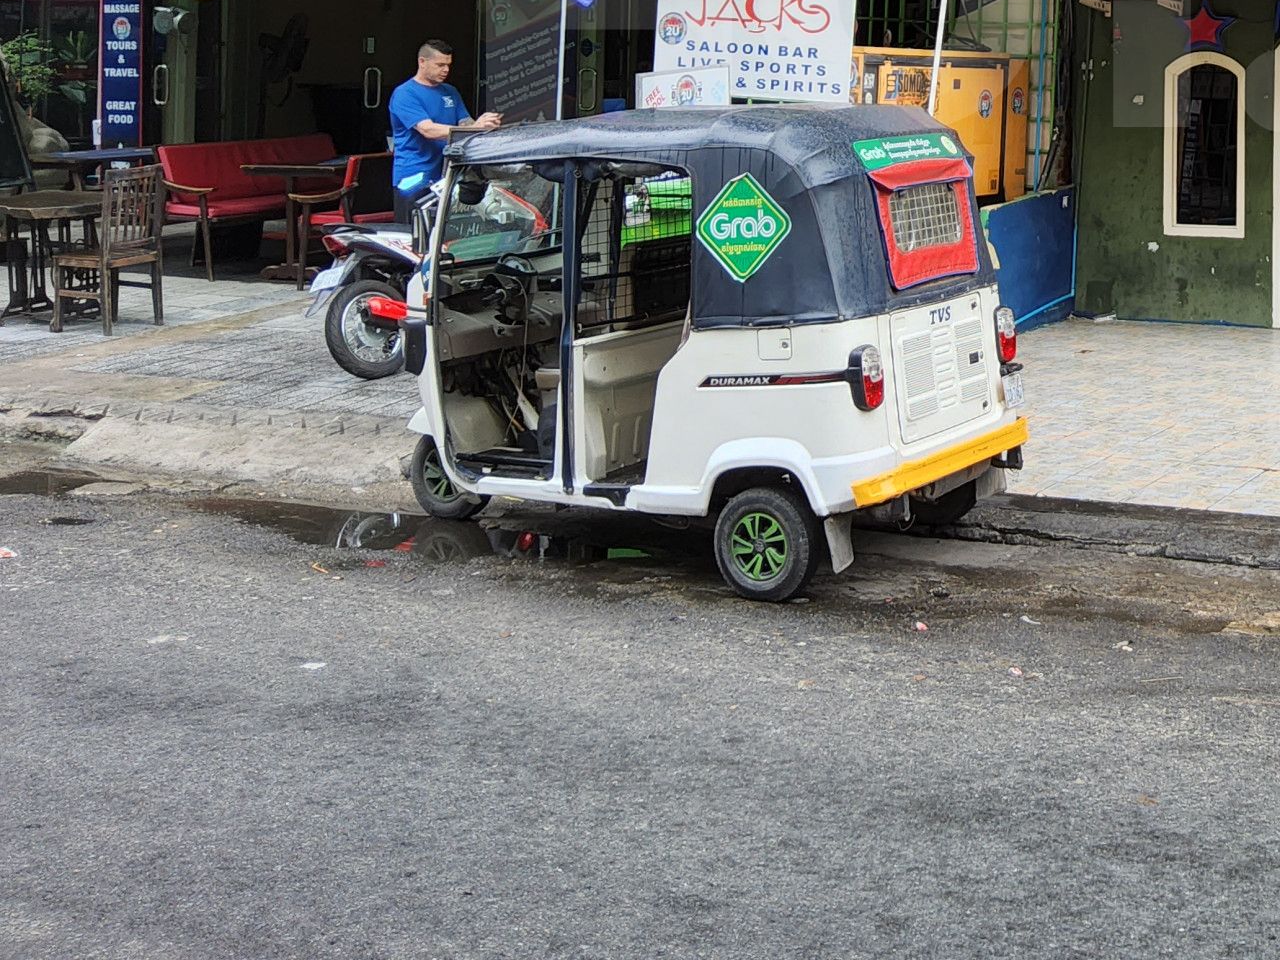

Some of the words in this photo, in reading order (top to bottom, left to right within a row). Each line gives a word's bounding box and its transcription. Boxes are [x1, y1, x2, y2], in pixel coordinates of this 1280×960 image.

[104, 4, 140, 14] MASSAGE
[106, 41, 137, 51] TOURS
[685, 40, 770, 56] SALOON
[778, 45, 819, 59] BAR
[118, 55, 125, 64] &
[104, 68, 139, 78] TRAVEL
[740, 60, 826, 76] SPORTS
[735, 76, 747, 89] &
[756, 78, 841, 94] SPIRITS
[106, 101, 136, 111] GREAT
[108, 114, 134, 124] FOOD
[859, 146, 887, 161] Grab
[710, 209, 776, 240] Grab
[929, 306, 951, 325] TVS
[710, 376, 771, 386] DURAMAX
